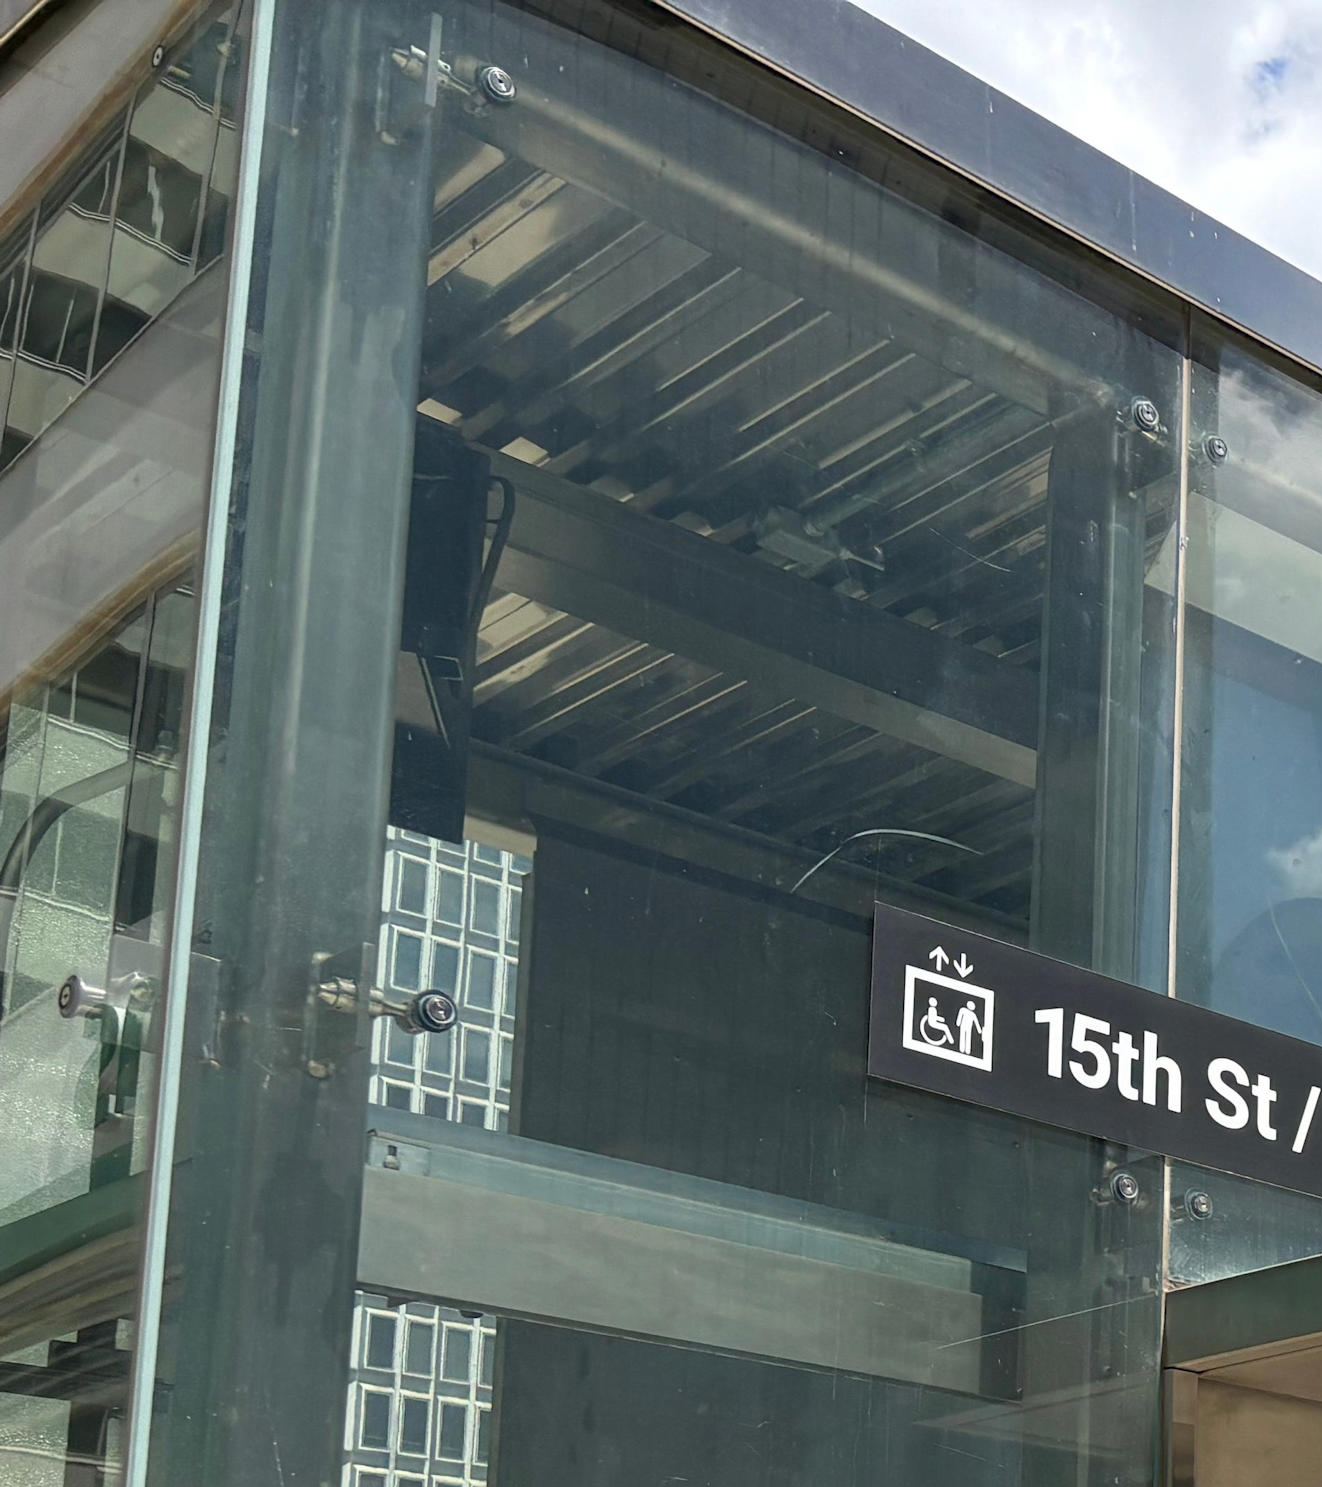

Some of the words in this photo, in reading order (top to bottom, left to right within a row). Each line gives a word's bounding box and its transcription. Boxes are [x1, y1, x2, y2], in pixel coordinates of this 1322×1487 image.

[1034, 1007, 1182, 1113] 15th
[1204, 1057, 1277, 1141] St
[1291, 1086, 1321, 1154] /
